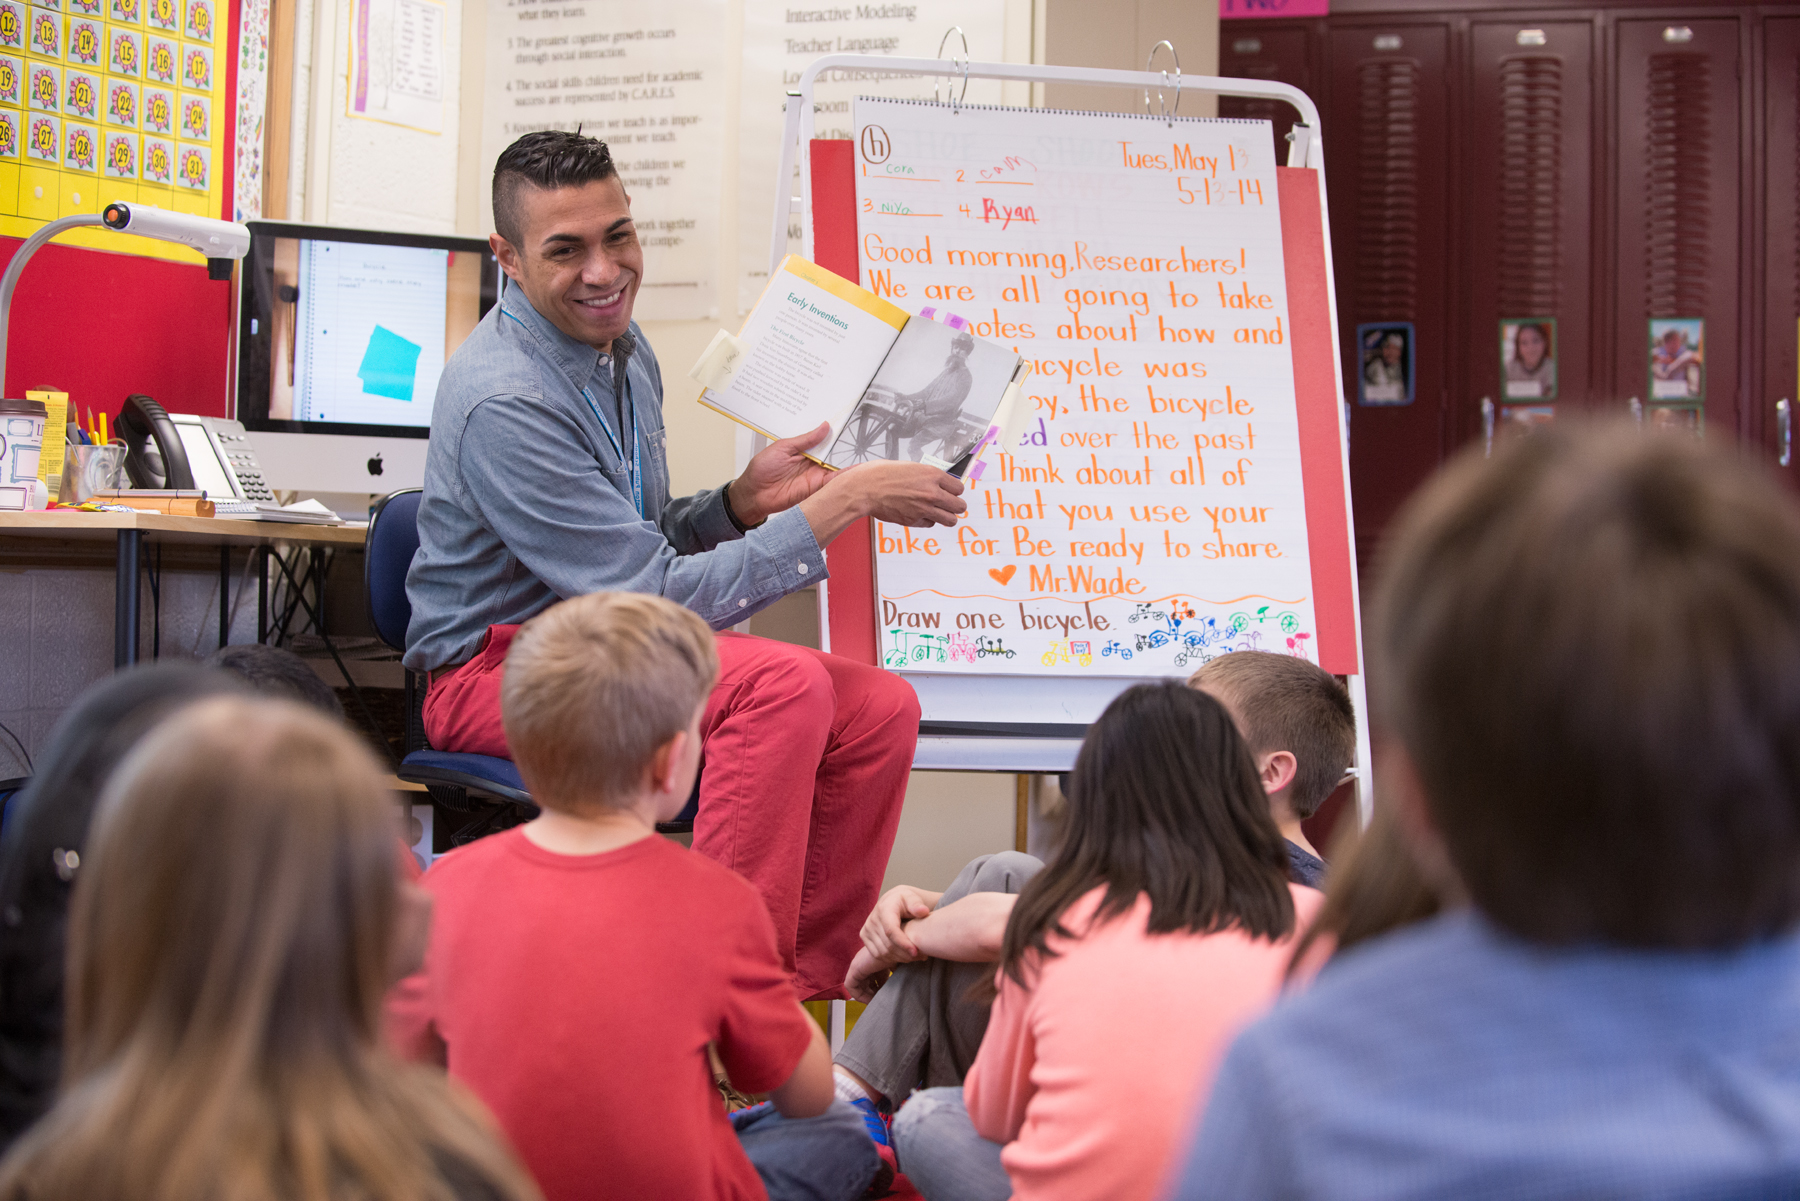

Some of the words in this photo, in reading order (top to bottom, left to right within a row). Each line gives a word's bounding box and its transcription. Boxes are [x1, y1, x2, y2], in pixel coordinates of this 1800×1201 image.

[163, 1, 168, 16] 9
[518, 9, 538, 21] what
[542, 8, 560, 21] they
[785, 6, 852, 24] Interactive
[854, 3, 917, 22] Modeling
[4, 16, 14, 32] 12
[198, 11, 207, 27] 10
[44, 26, 52, 42] 13
[81, 34, 91, 50] 14
[516, 36, 533, 48] The
[535, 34, 569, 49] greatest
[572, 32, 610, 46] cognitive
[613, 29, 644, 44] growth
[647, 28, 676, 39] occurs
[784, 38, 834, 54] Teacher
[836, 36, 900, 54] Language
[122, 46, 132, 62] 15
[158, 54, 168, 70] 16
[515, 50, 550, 64] through
[552, 48, 575, 61] social
[195, 60, 204, 75] 17
[1, 70, 12, 87] 19
[516, 80, 532, 90] The
[534, 78, 558, 90] social
[561, 76, 582, 88] skills
[585, 73, 620, 87] children
[623, 72, 644, 84] need
[647, 71, 660, 83] for
[662, 70, 704, 82] academic
[42, 80, 52, 96] 20
[78, 88, 88, 104] 21
[120, 96, 130, 112] 22
[515, 96, 546, 107] success
[548, 95, 560, 106] are
[564, 90, 616, 105] represented
[619, 89, 630, 103] by
[155, 104, 166, 120] 23
[193, 110, 202, 125] 24
[513, 122, 550, 134] Knowing
[554, 120, 566, 131] the
[569, 118, 604, 130] children
[608, 118, 620, 128] we
[623, 116, 646, 128] teach
[650, 115, 656, 126] is
[659, 116, 668, 126] as
[671, 114, 703, 127] impor-
[0, 125, 10, 142] 26
[41, 130, 52, 146] 27
[602, 132, 632, 145] ontent
[636, 133, 650, 144] we
[78, 140, 88, 156] 28
[118, 148, 128, 163] 29
[154, 154, 165, 170] 30
[617, 160, 630, 171] the
[633, 158, 670, 171] children
[672, 160, 686, 169] we
[1228, 144, 1248, 172] 13
[190, 160, 200, 175] 31
[620, 177, 654, 188] nowing
[656, 176, 671, 186] the
[1177, 176, 1264, 206] 5-13-14
[982, 198, 1038, 230] Ryan
[635, 220, 656, 230] work
[659, 218, 696, 232] together
[864, 233, 932, 264] Good
[868, 268, 908, 298] We
[924, 284, 976, 301] are
[1002, 274, 1040, 304] all
[1064, 284, 1150, 316] going
[1168, 281, 1198, 308] to
[1218, 281, 1274, 310] take
[786, 292, 808, 311] Early
[808, 302, 849, 330] Inventions
[968, 308, 1036, 339] notes
[1056, 312, 1137, 342] about
[1158, 315, 1216, 344] how
[1233, 316, 1284, 345] and
[1144, 362, 1208, 379] was
[1079, 384, 1130, 412] the
[1147, 385, 1254, 422] bicycle
[1060, 432, 1119, 449] over
[1132, 421, 1180, 450] the
[1194, 422, 1258, 458] past
[1076, 453, 1154, 486] about
[1170, 456, 1206, 486] all
[1222, 458, 1254, 486] of
[984, 488, 1048, 520] that
[1058, 504, 1114, 531] you
[1129, 505, 1191, 524] use
[1203, 506, 1274, 533] your
[878, 522, 942, 556] bike
[1012, 526, 1056, 557] Be
[1070, 528, 1144, 566] ready
[1162, 530, 1191, 558] to
[882, 600, 941, 629] Draw
[956, 612, 1006, 630] one
